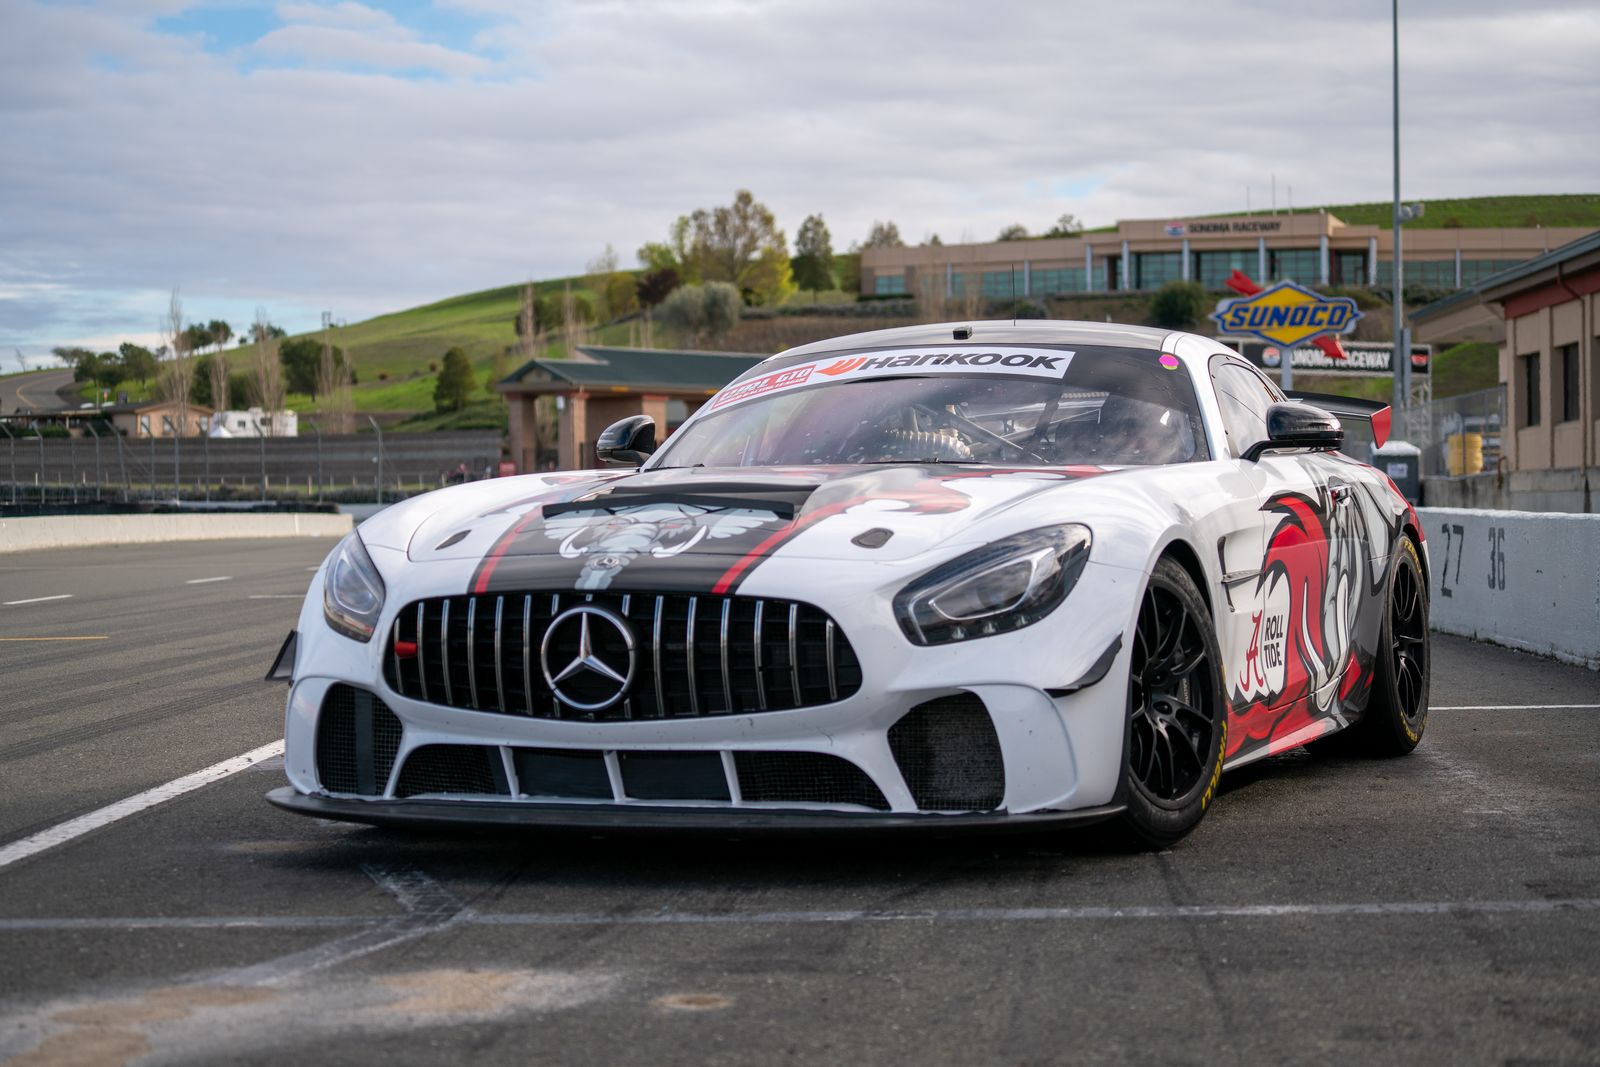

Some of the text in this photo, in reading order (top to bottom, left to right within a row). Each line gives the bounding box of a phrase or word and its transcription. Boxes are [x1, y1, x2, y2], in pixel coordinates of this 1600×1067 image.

[1232, 221, 1282, 232] RACEWAY
[1228, 305, 1348, 326] SUNOCO
[1441, 523, 1464, 598] 27
[1487, 527, 1505, 591] 36
[1265, 614, 1284, 642] ROLL
[1263, 642, 1283, 669] TIDE
